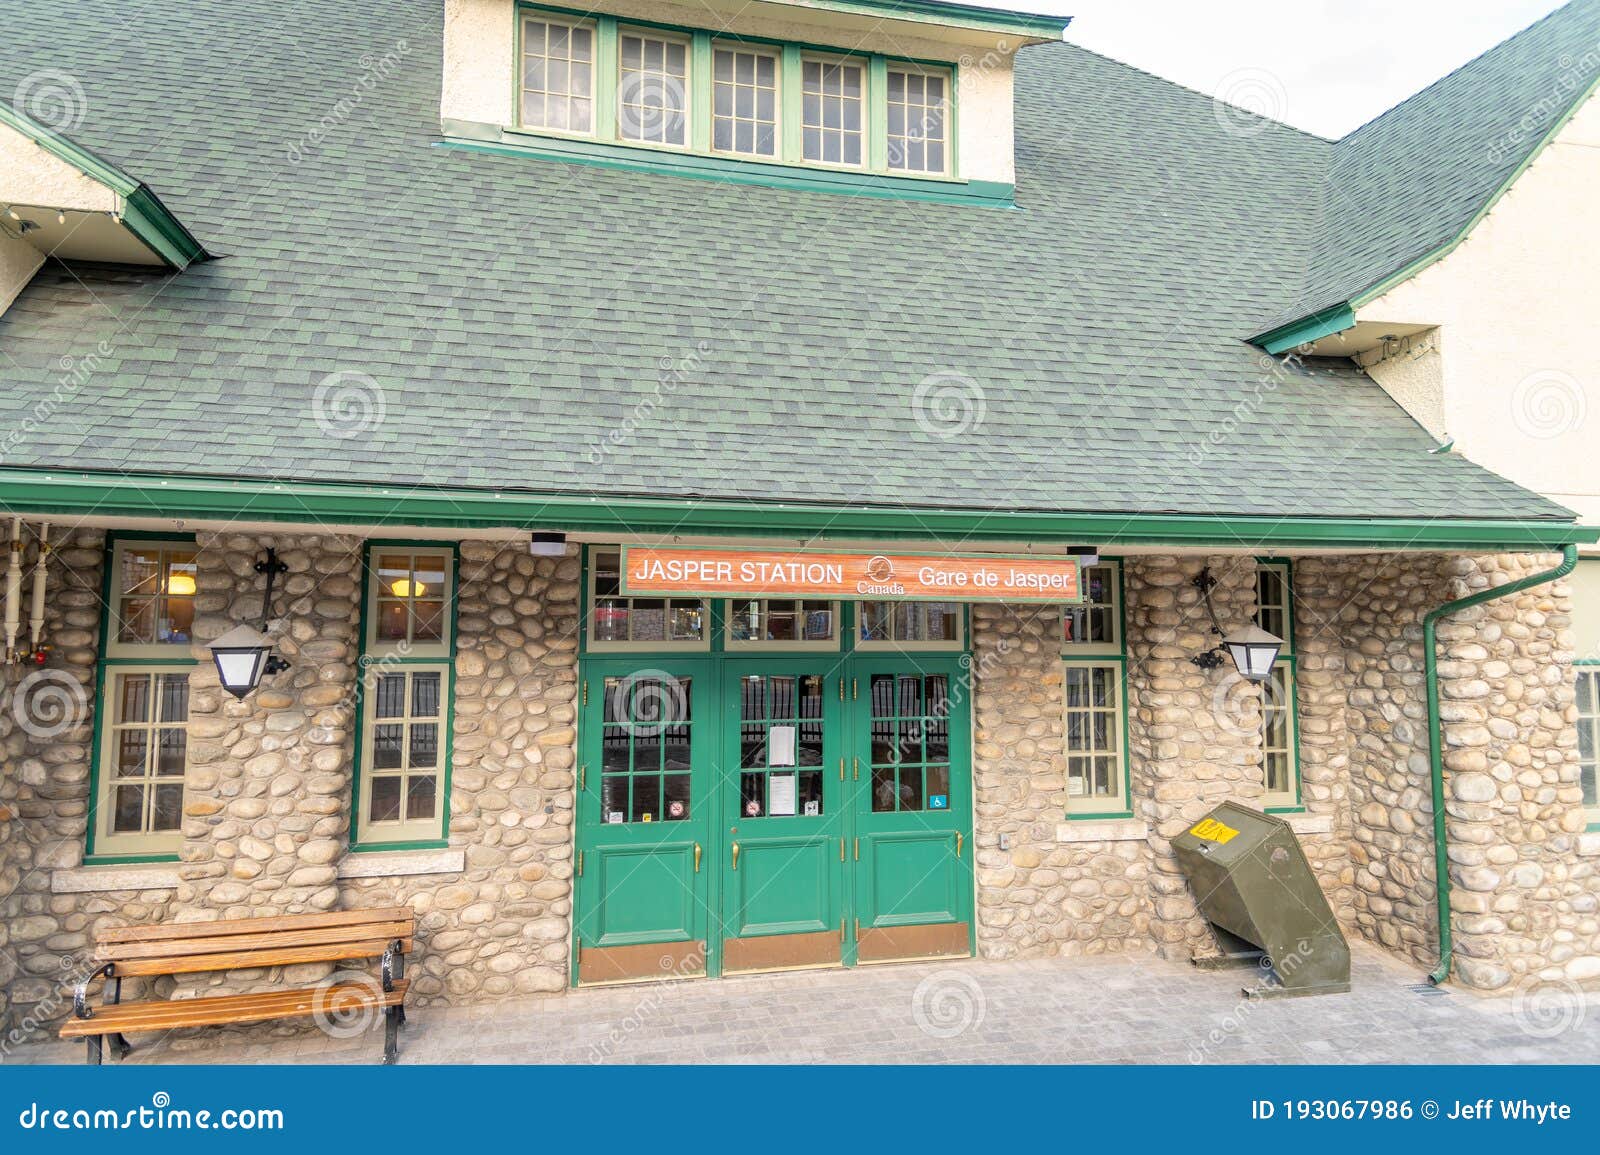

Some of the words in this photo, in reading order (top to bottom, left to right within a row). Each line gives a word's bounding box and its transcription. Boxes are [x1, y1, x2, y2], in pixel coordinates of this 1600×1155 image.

[636, 560, 732, 581] JASPER
[740, 561, 843, 584] STATION
[918, 566, 968, 586] Gare
[973, 568, 999, 587] de
[1004, 568, 1070, 592] Jasper
[856, 581, 905, 595] Canada
